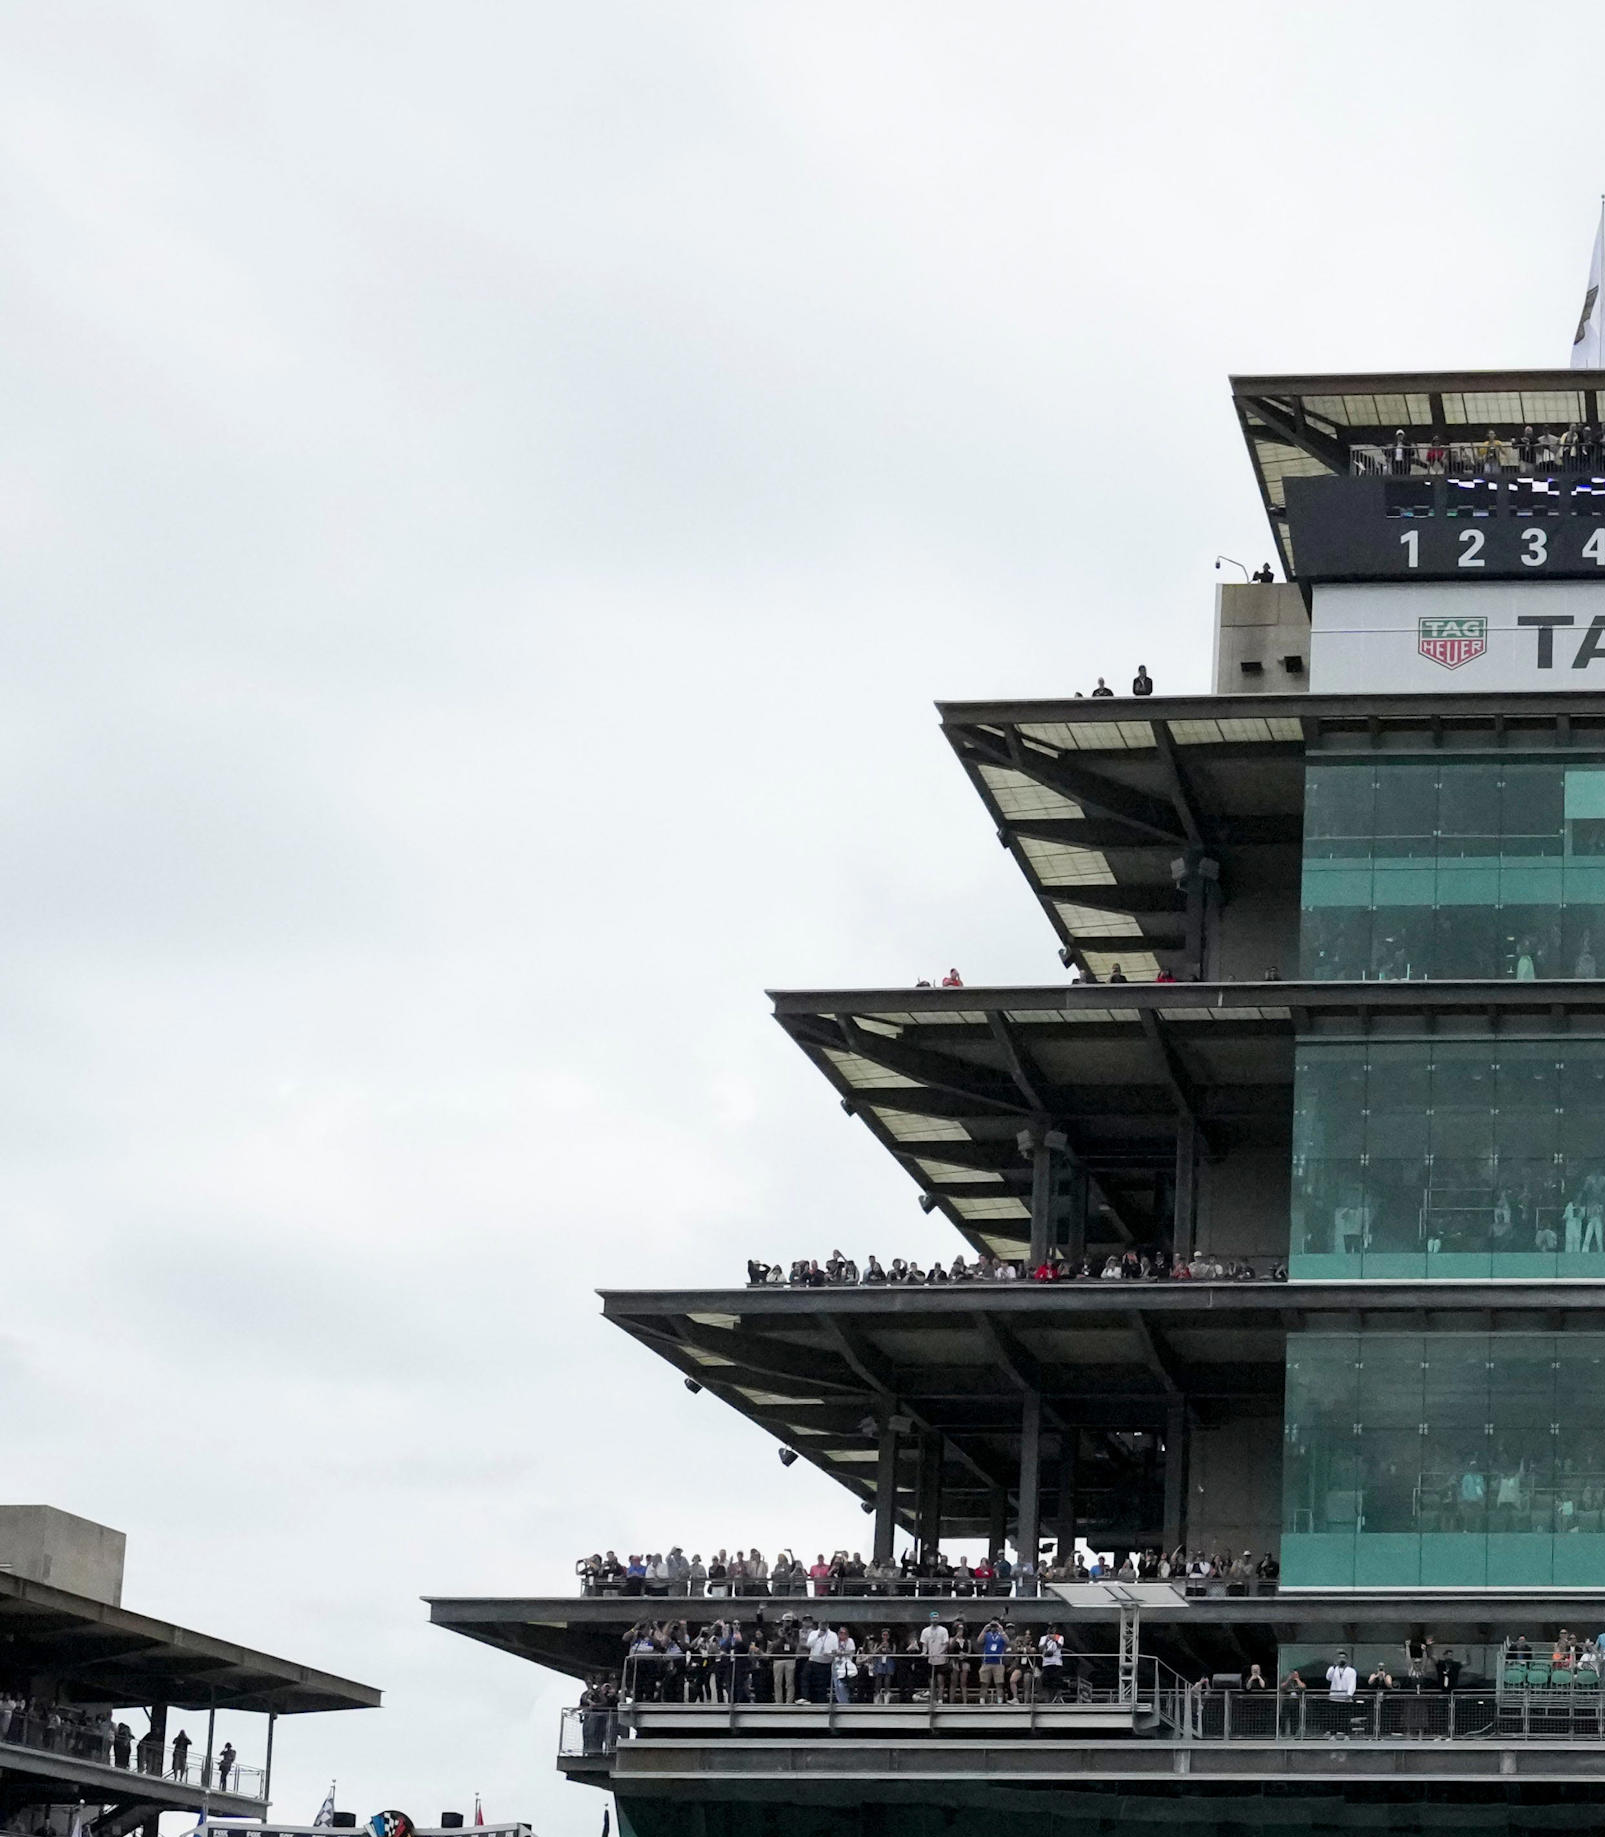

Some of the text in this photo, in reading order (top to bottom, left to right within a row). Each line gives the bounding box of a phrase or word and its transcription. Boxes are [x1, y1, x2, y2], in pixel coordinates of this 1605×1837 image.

[1400, 530, 1419, 568] 1
[1458, 529, 1485, 567] 2
[1520, 527, 1548, 567] 3
[1422, 618, 1484, 638] TAG
[1421, 638, 1484, 666] HEUER
